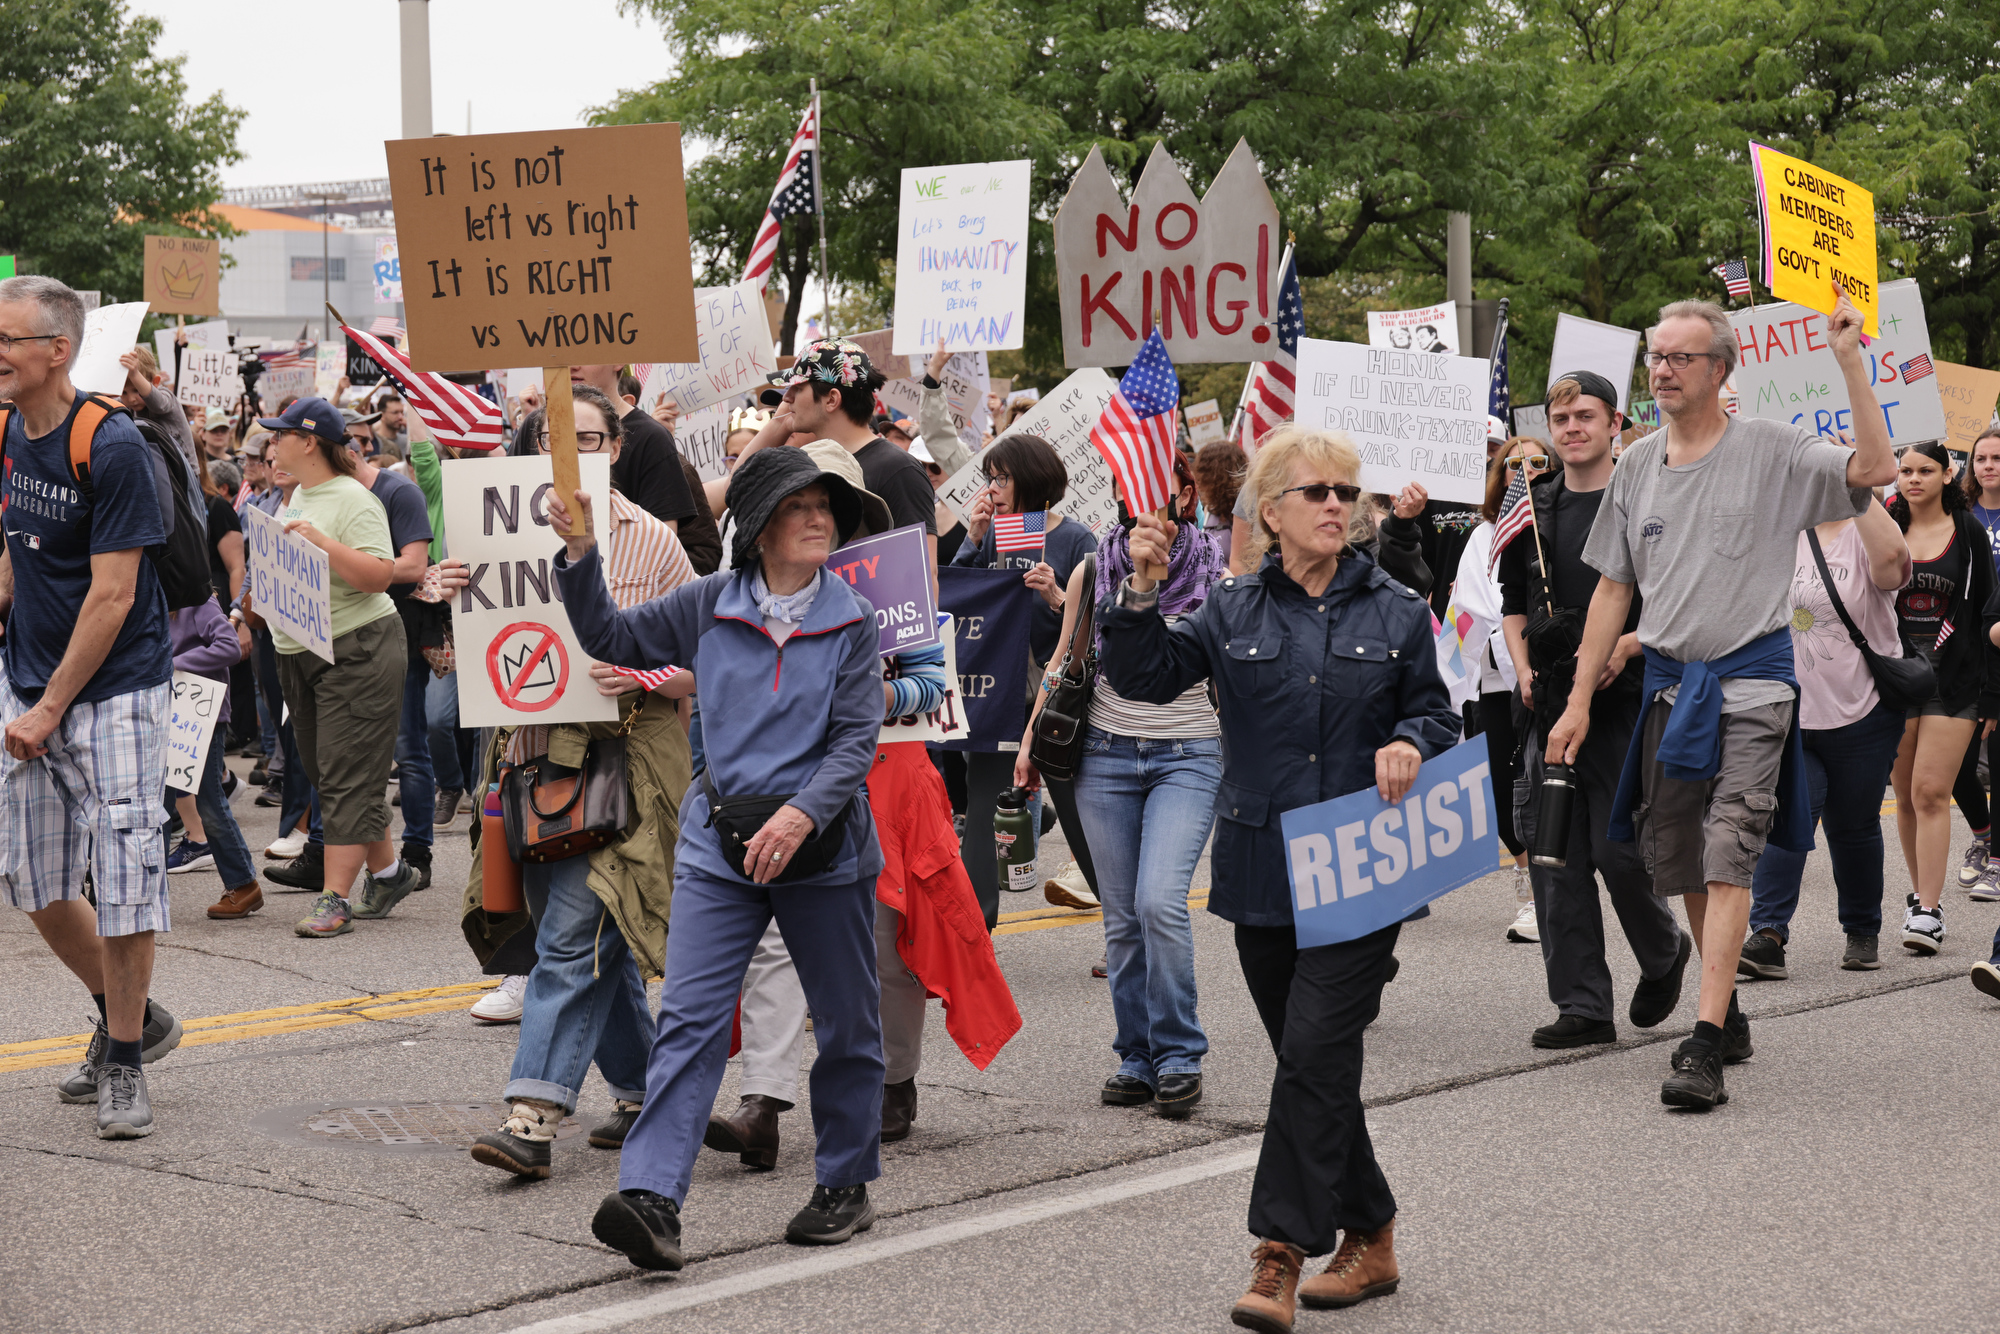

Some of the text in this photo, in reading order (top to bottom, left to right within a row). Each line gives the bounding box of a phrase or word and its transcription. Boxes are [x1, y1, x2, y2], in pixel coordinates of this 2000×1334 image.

[420, 145, 564, 196] It is not
[915, 175, 946, 198] WE
[1784, 167, 1846, 207] CABINET
[465, 195, 639, 249] left vs right
[913, 214, 986, 239] Let's Bring
[1096, 202, 1198, 258] NO
[1779, 193, 1854, 240] MEMBERS
[158, 238, 175, 250] NO
[919, 239, 1018, 275] HUMANITY
[1812, 230, 1841, 257] ARE
[373, 258, 401, 287] RE
[427, 256, 612, 298] It is RIGHT
[969, 278, 982, 292] to
[1080, 223, 1271, 348] KING!
[1778, 246, 1870, 303] GOV'T WASTE
[707, 298, 724, 330] IS
[732, 290, 747, 319] A
[946, 296, 978, 312] BEING
[1398, 311, 1446, 326] OLIGARCHS
[1402, 309, 1431, 319] TRUMP
[471, 312, 638, 349] vs WRONG
[720, 326, 742, 354] OF
[920, 311, 1013, 348] HUMAN
[1735, 314, 1827, 367] HATE
[706, 345, 770, 394] WEAK
[1367, 350, 1448, 380] HONK
[664, 380, 705, 411] THE
[892, 380, 921, 406] IMM
[941, 375, 968, 398] ARE
[1313, 372, 1471, 412] IF U NEVER
[1757, 379, 1831, 414] Make
[1939, 382, 1976, 405] GRESS
[1019, 416, 1050, 439] ings
[1060, 387, 1083, 413] are
[1324, 406, 1488, 446] DRUNK-TEXTED
[1516, 407, 1545, 427] NO
[1958, 415, 1983, 433] JOB
[1411, 447, 1484, 480] PLANS
[12, 472, 78, 504] CLEVELAND
[1087, 474, 1109, 496] out
[10, 490, 67, 523] BASEBALL
[250, 521, 321, 592] NO HUMAN
[1811, 565, 1848, 580] KND
[1917, 572, 1955, 596] STATE
[256, 567, 327, 643] IS ILLEGAL
[876, 601, 923, 630] ONS.
[896, 622, 925, 640] ACLU
[174, 681, 215, 718] Peo
[1289, 760, 1490, 911] RESIST
